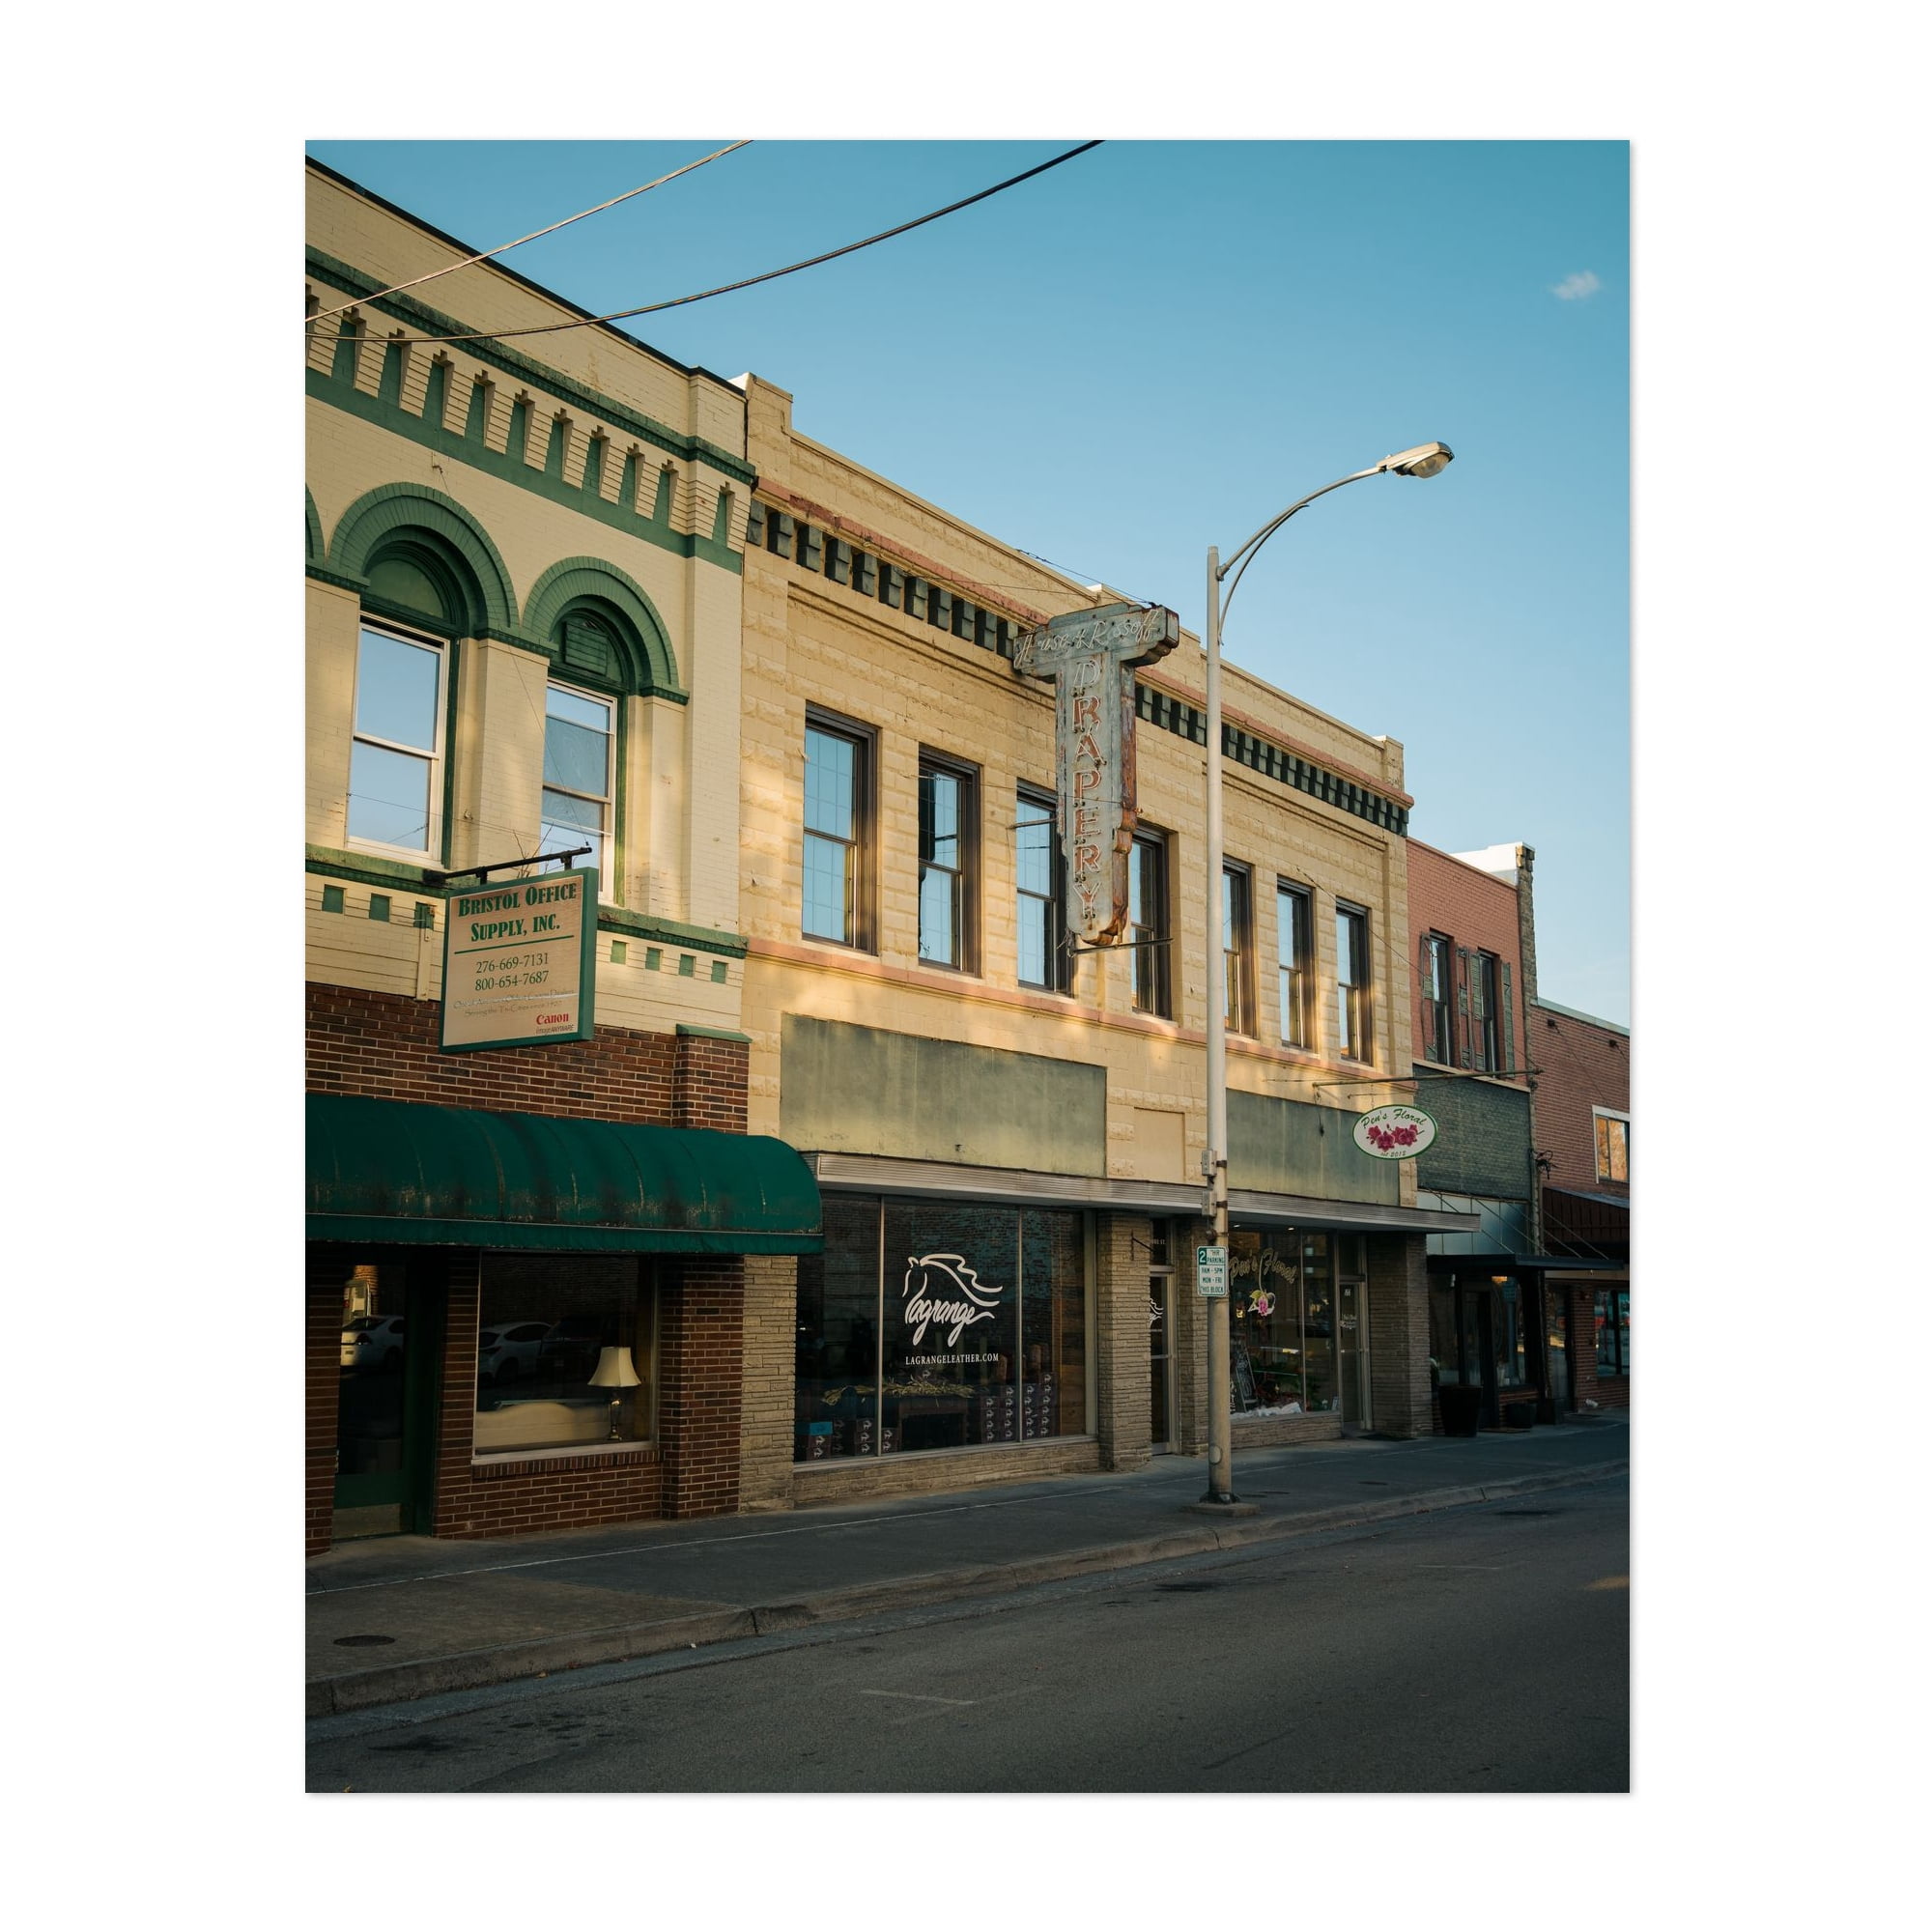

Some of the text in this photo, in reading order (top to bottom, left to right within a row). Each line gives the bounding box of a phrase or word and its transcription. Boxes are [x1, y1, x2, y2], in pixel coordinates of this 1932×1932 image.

[1013, 634, 1069, 669] Huse
[1072, 659, 1108, 917] DRAPERY
[458, 883, 577, 917] BRISTOL OFFICE
[471, 914, 560, 942] SUPPLY, INC.
[475, 952, 549, 974] 276-669-7131
[475, 970, 550, 991] 800-654-7687
[536, 1012, 570, 1026] Canon
[1360, 1108, 1428, 1129] Pen's Floral
[1199, 1250, 1207, 1264] 2
[904, 1298, 995, 1349] lagrange
[905, 1352, 999, 1365] LAGRANGELEATHER.COM
